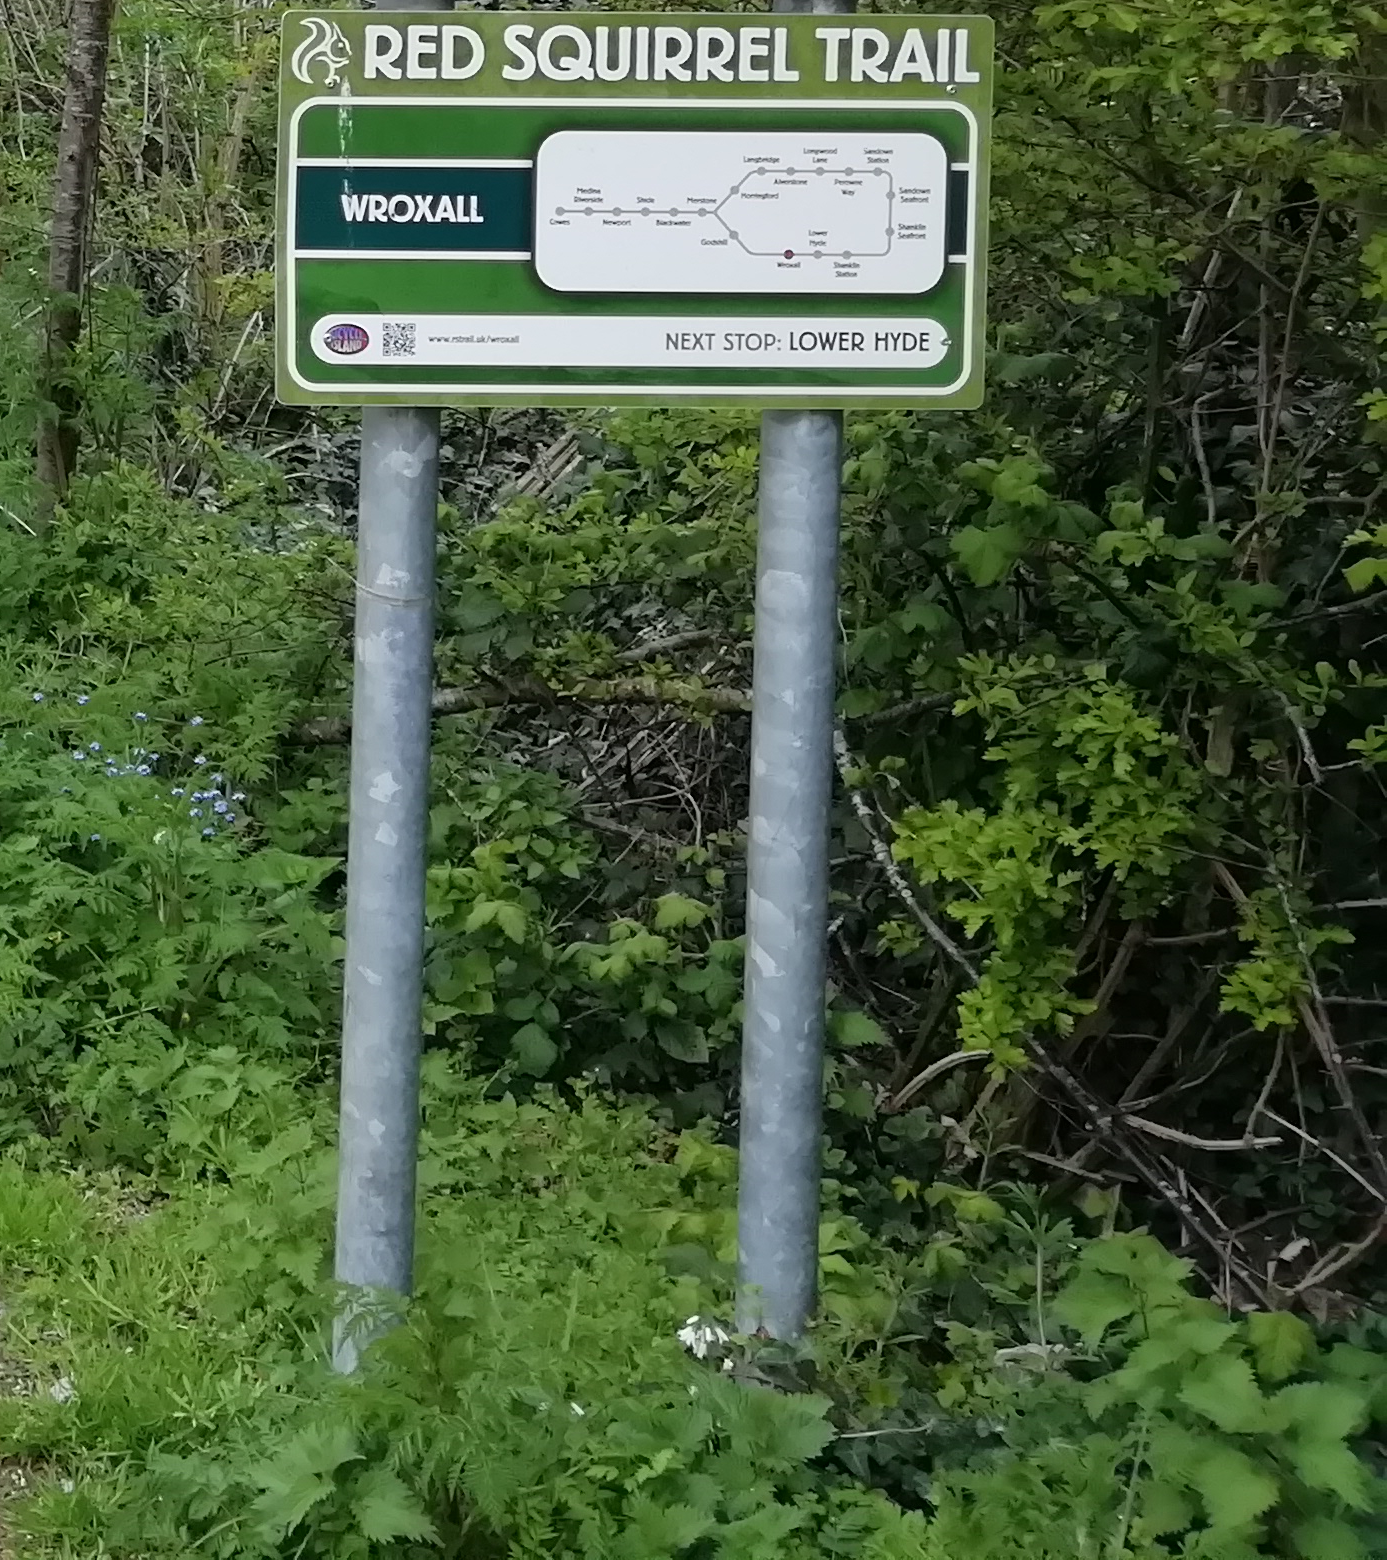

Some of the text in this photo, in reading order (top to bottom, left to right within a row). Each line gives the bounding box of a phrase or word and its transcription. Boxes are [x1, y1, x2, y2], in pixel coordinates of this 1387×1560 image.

[363, 25, 980, 83] RED SQUIRREL TRAIL
[341, 194, 483, 223] WROXALL
[665, 332, 930, 352] NEXT STOP: LOWER HYDE
